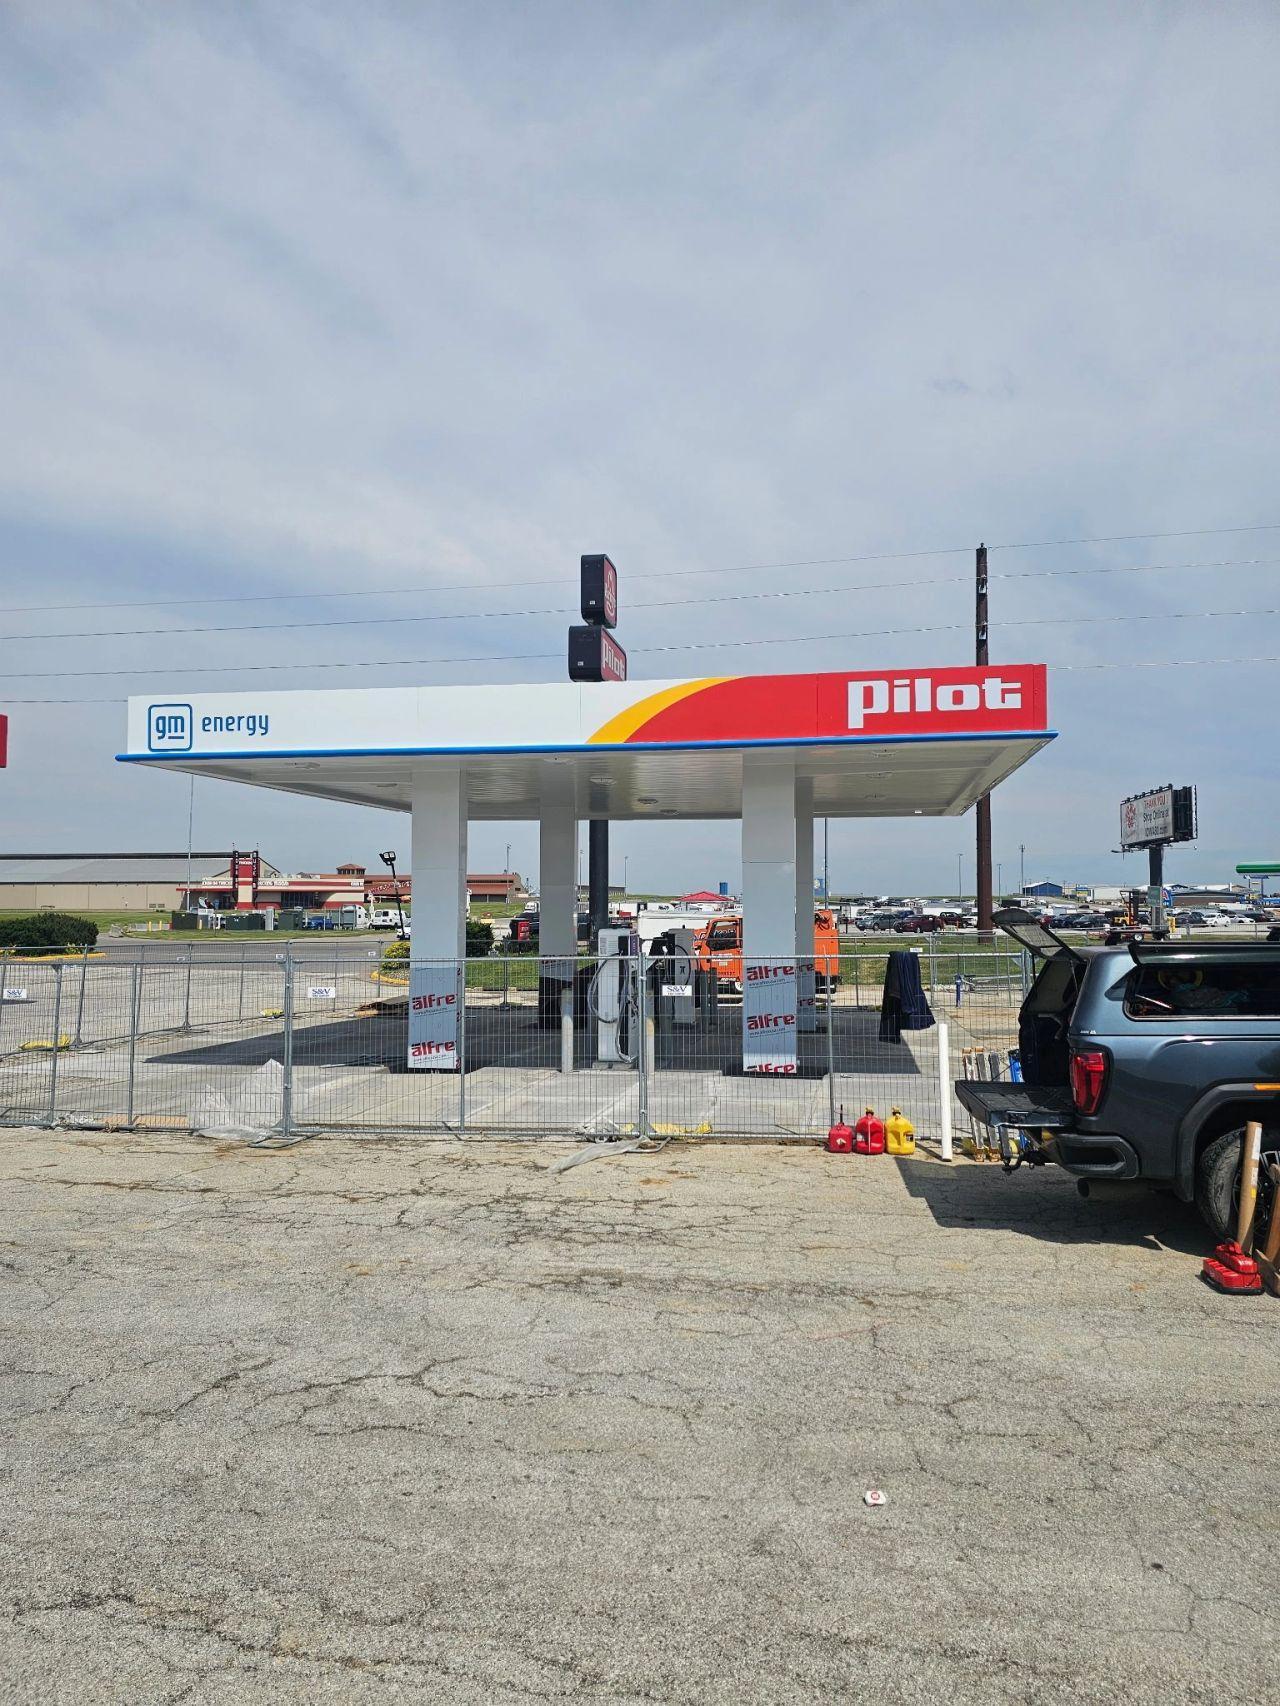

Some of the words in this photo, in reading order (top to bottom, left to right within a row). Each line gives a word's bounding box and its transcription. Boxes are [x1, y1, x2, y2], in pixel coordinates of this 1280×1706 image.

[847, 677, 1022, 729] pilot
[155, 715, 185, 740] gm
[201, 714, 269, 736] energy
[412, 993, 458, 1010] alfre
[411, 1040, 457, 1057] alfre
